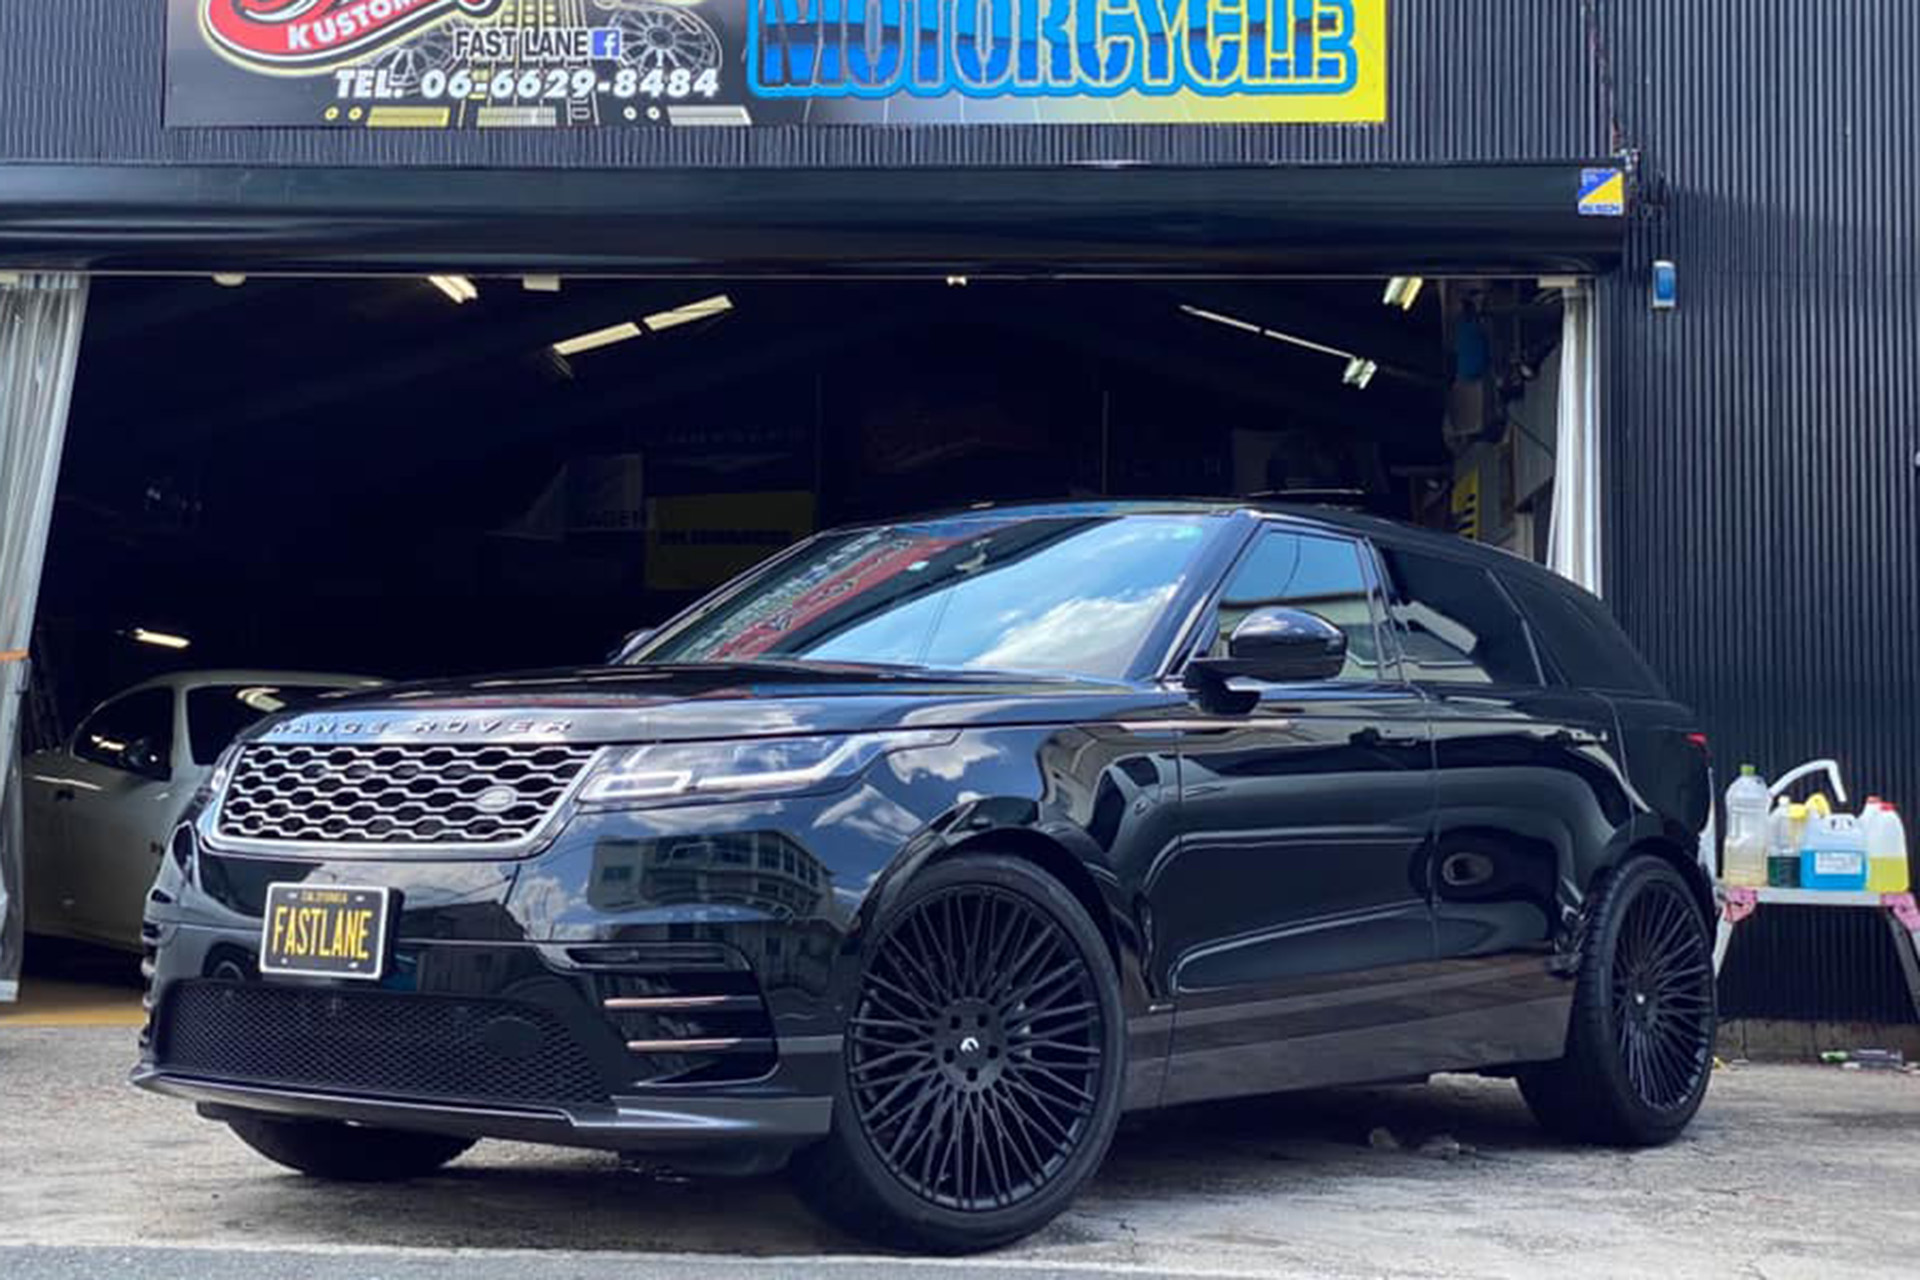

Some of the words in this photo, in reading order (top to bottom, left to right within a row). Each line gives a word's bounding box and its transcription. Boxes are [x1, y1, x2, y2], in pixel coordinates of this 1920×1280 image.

[454, 28, 518, 58] FAST
[523, 28, 589, 58] LANE
[748, 0, 1357, 97] MOTORCYCLE
[335, 69, 404, 98] TEL.
[421, 68, 720, 98] 06-6629-8484
[270, 721, 390, 735] RANGE
[414, 719, 573, 734] ROVER
[272, 905, 373, 960] FASTLANE
